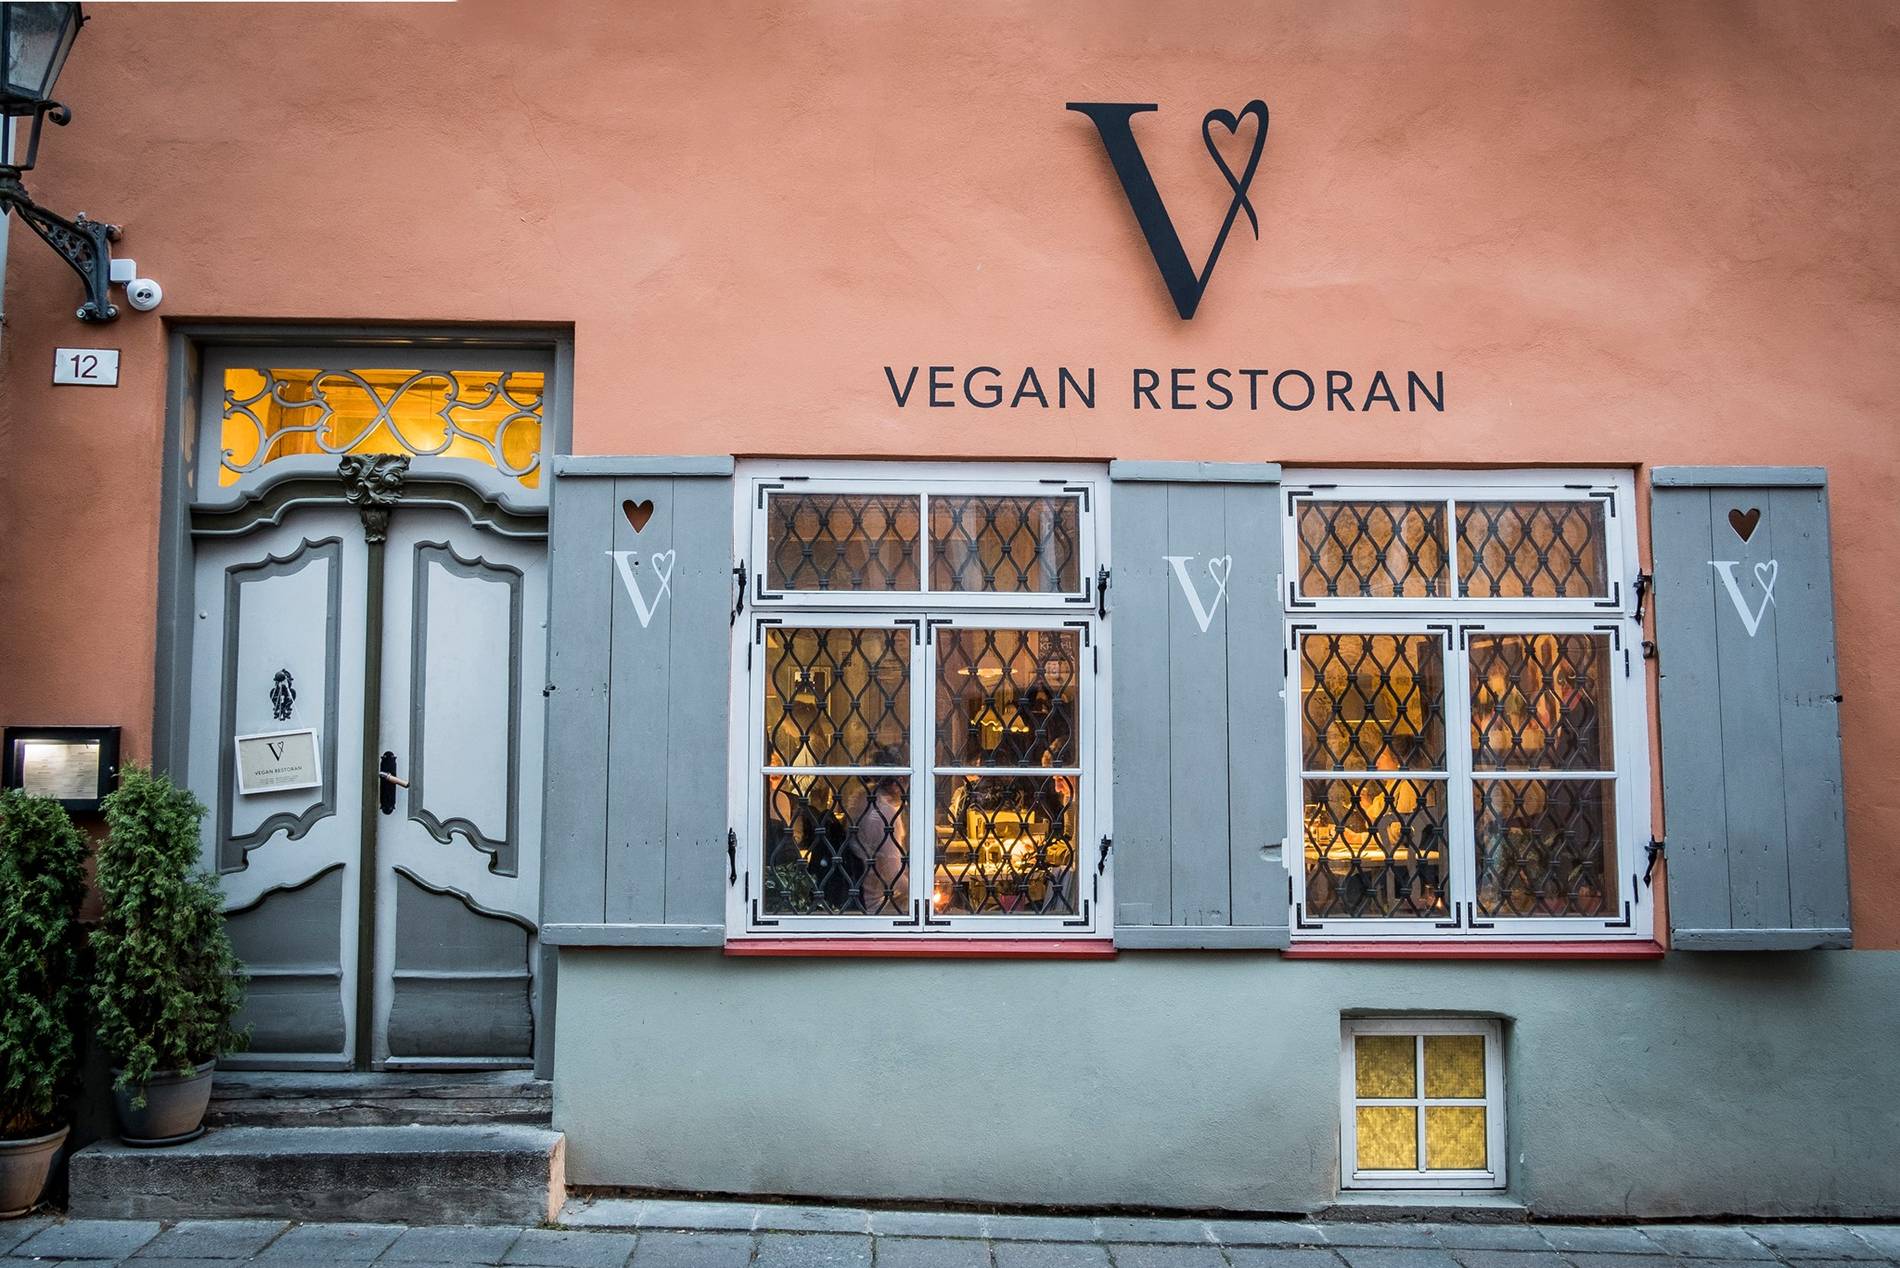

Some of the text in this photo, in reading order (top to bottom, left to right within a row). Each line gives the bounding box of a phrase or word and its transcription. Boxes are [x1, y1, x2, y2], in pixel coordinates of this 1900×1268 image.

[1066, 100, 1269, 320] V
[70, 355, 98, 379] 12
[884, 366, 1445, 412] VEGAN RESTORAN
[604, 549, 676, 628] V
[1161, 554, 1232, 632] V
[1707, 559, 1778, 637] V
[254, 768, 274, 776] VEGAN
[266, 741, 285, 761] V
